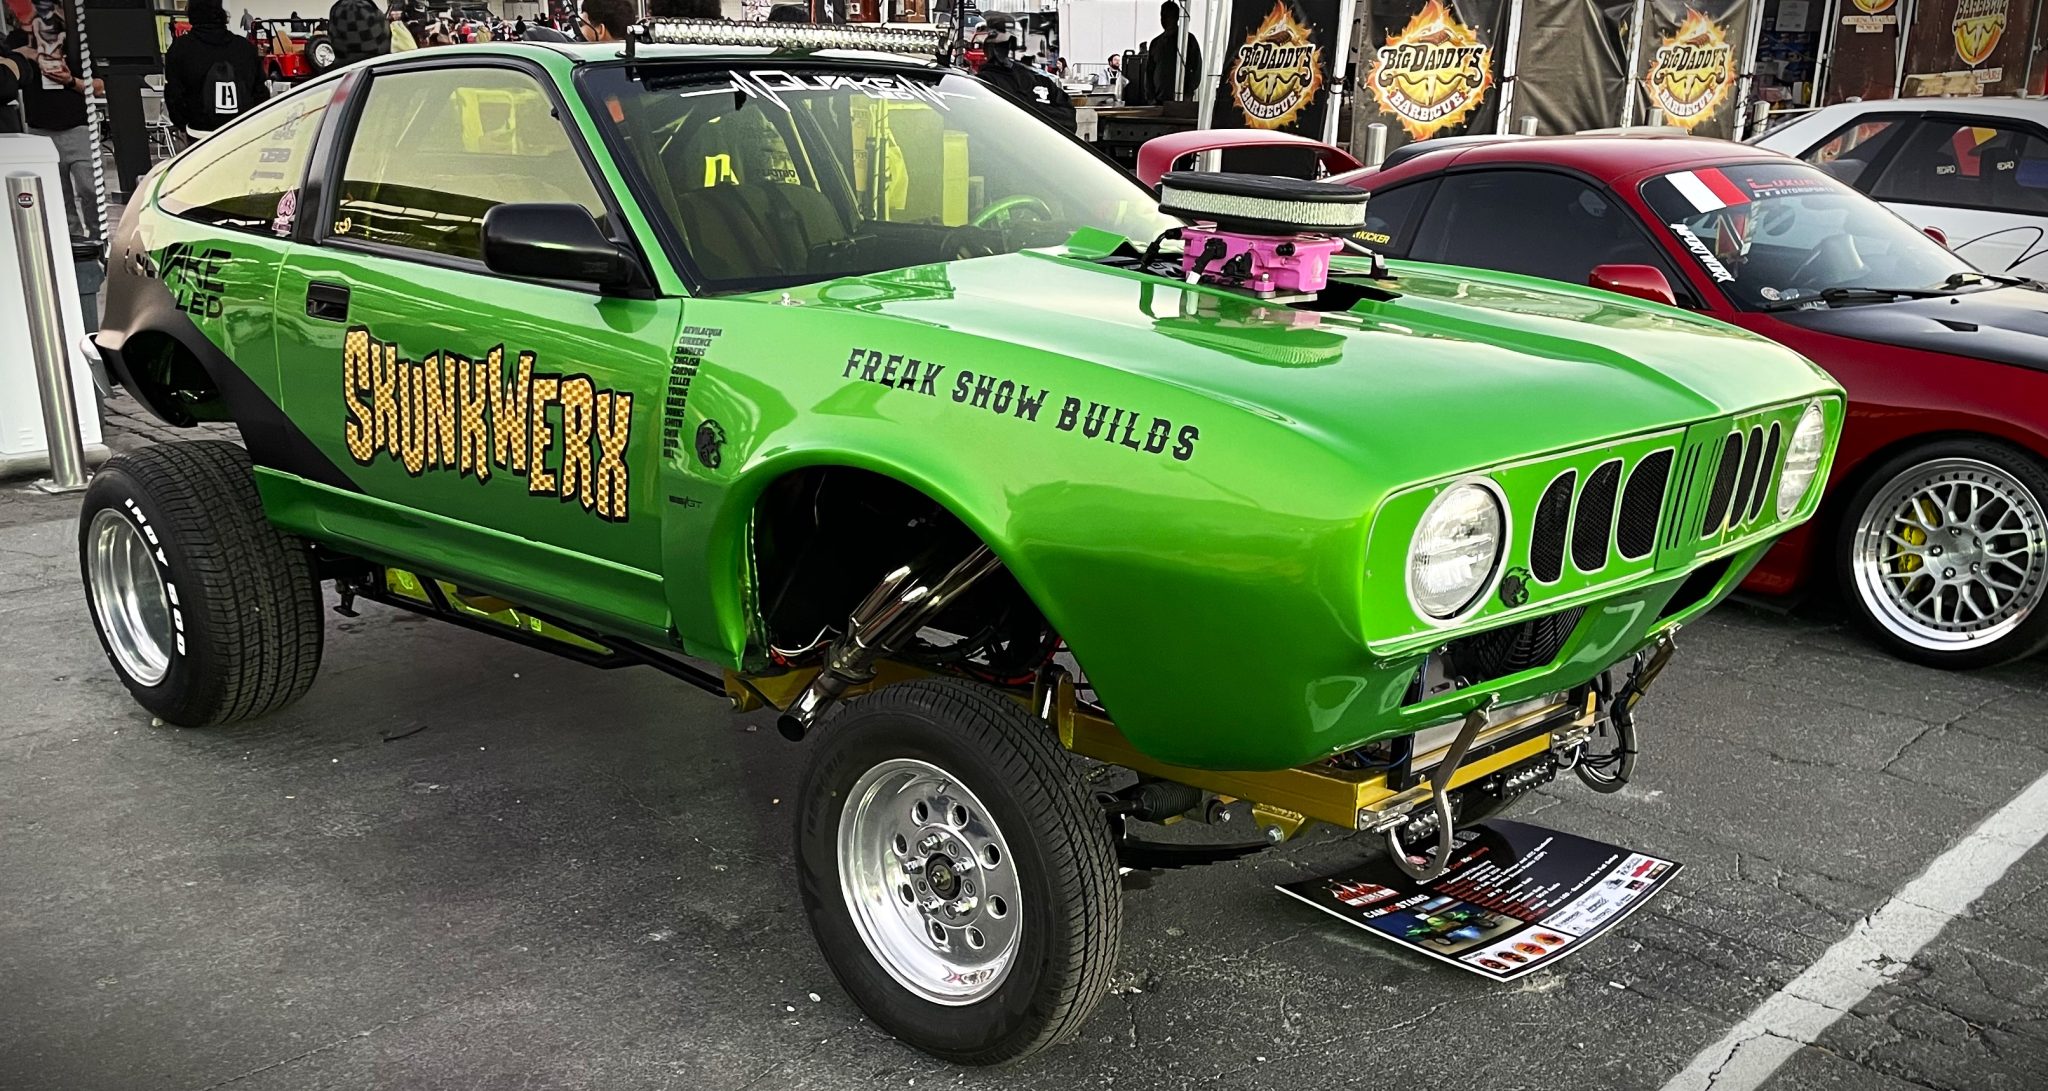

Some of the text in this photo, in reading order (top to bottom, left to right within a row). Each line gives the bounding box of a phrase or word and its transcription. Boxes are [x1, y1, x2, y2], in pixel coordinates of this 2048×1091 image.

[1240, 87, 1298, 119] BARBECUE
[1359, 231, 1391, 245] KICKER
[175, 289, 224, 319] LED
[344, 325, 633, 522] SKUNKWERX
[842, 347, 1200, 461] FREAK SHOW BUILDS
[124, 497, 186, 656] INDY 500
